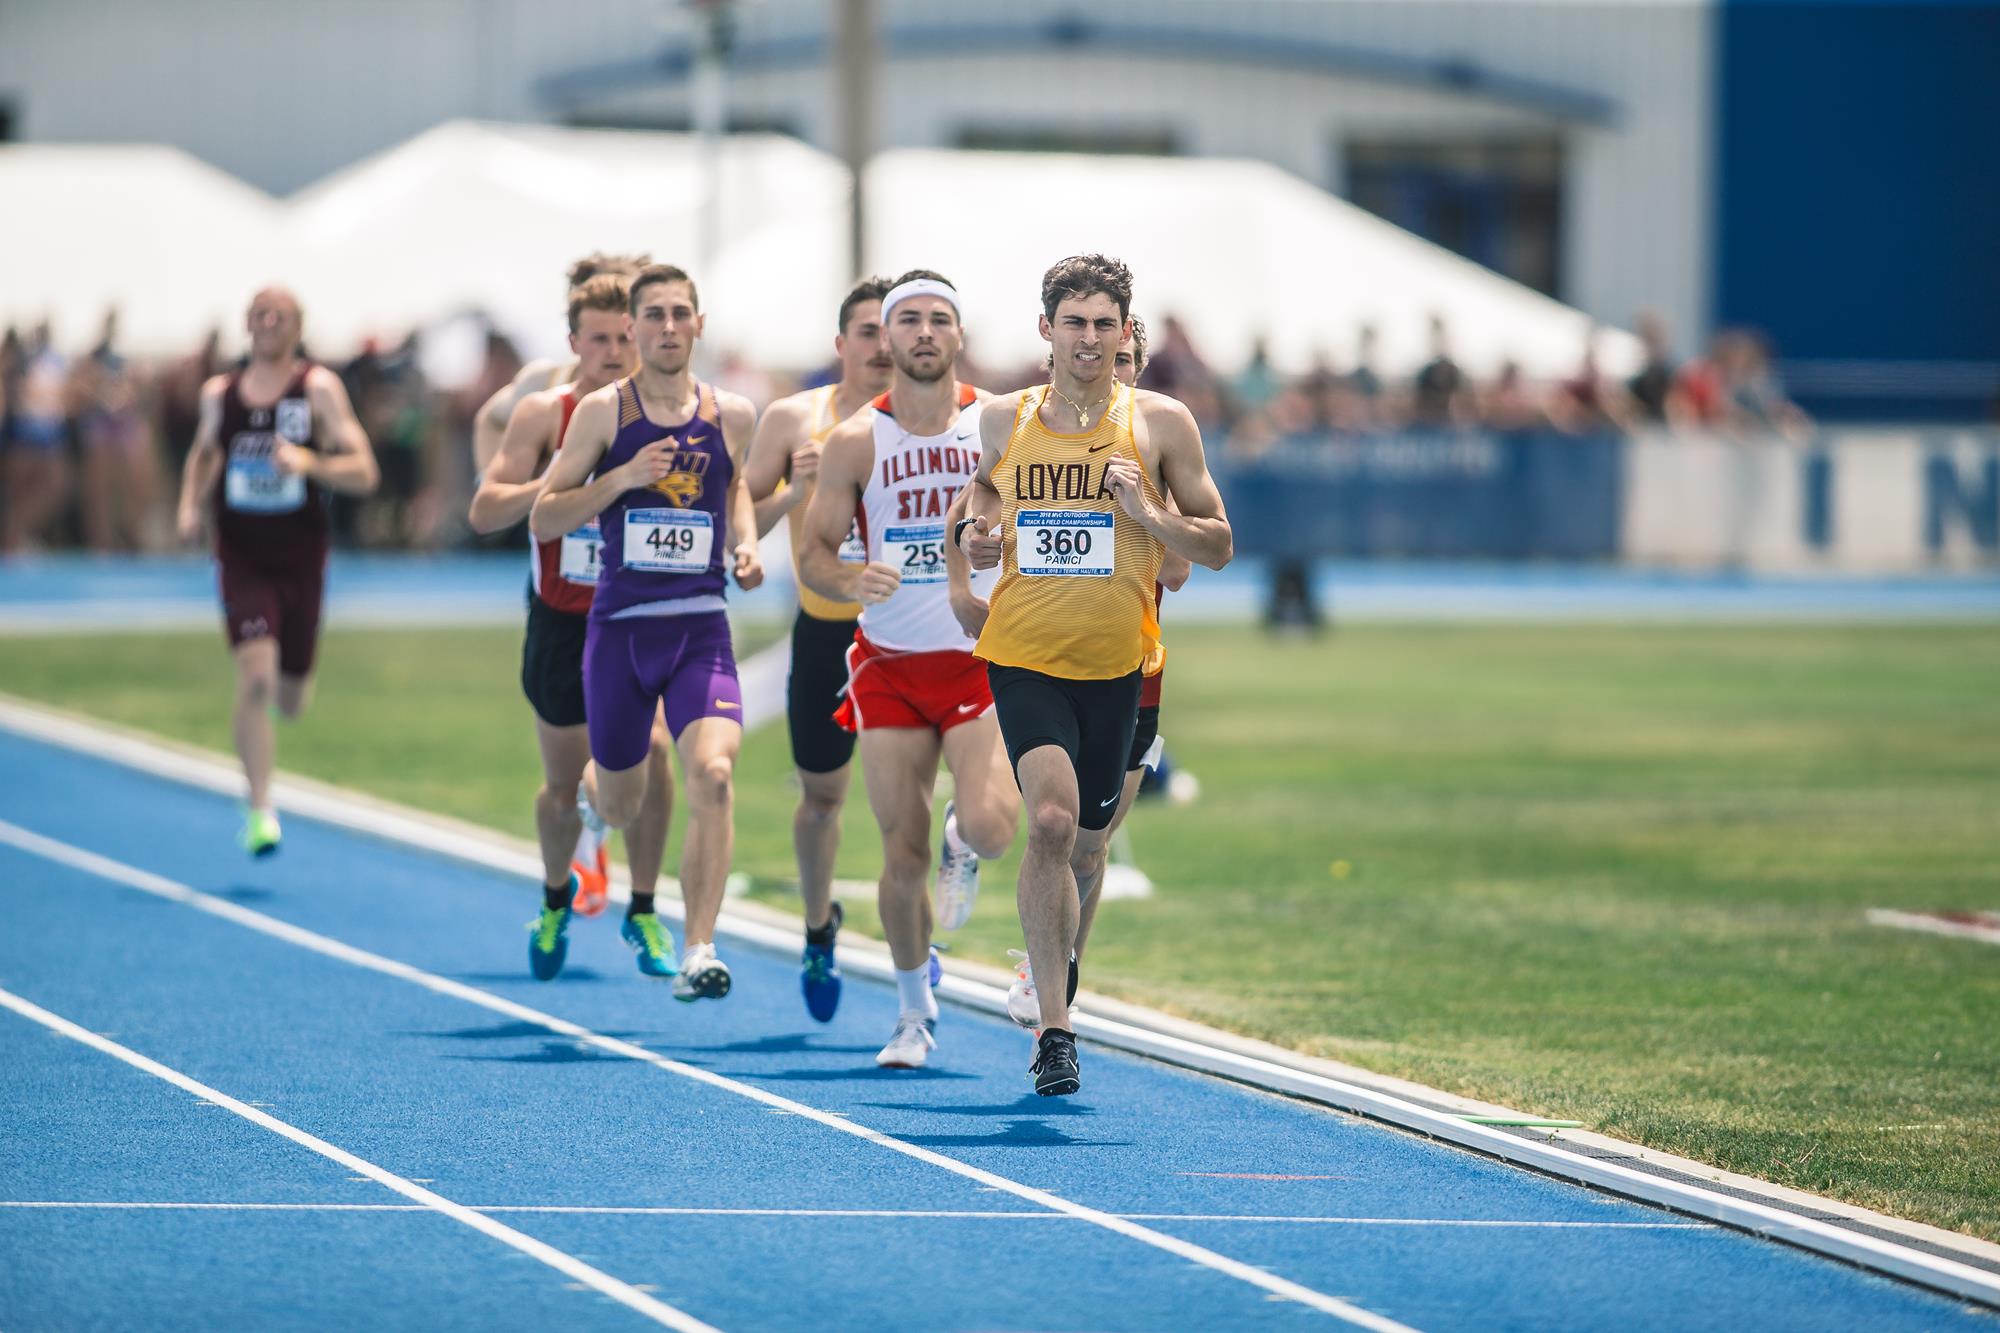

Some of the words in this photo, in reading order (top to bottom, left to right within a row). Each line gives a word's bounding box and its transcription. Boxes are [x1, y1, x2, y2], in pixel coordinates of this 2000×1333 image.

[1015, 463, 1114, 501] LOYOLA
[897, 485, 965, 519] STAT
[646, 528, 693, 552] 449
[1036, 529, 1092, 556] 360
[1044, 555, 1082, 565] PANICI
